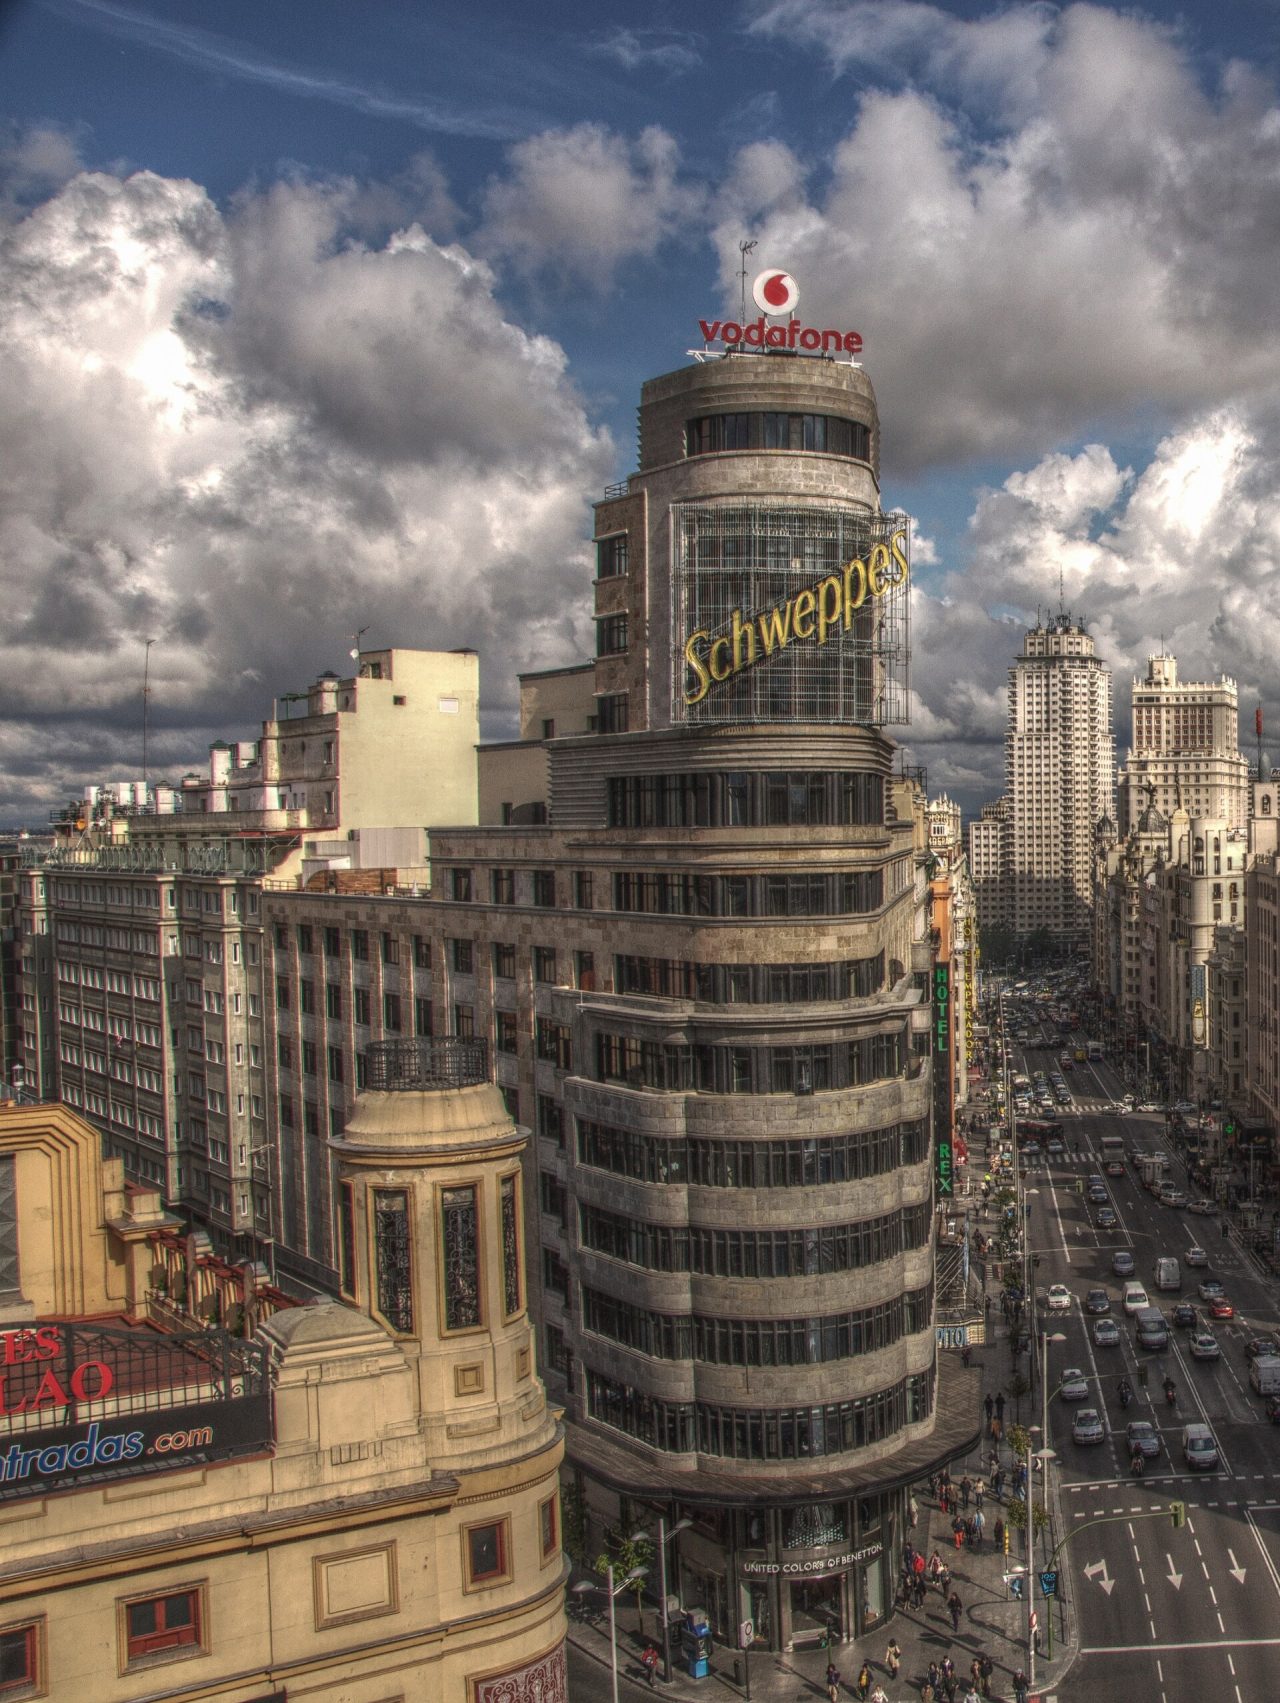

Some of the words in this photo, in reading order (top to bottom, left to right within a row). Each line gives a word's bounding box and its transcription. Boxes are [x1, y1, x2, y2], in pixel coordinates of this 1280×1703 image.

[698, 317, 863, 353] vodafone
[684, 529, 909, 706] Schweppes
[935, 968, 949, 1052] HOTEL
[964, 971, 974, 1060] EMPERADOR
[937, 1143, 953, 1192] REX
[744, 1563, 780, 1574] UNITED
[782, 1560, 825, 1574] COLORS
[827, 1556, 841, 1569] OF
